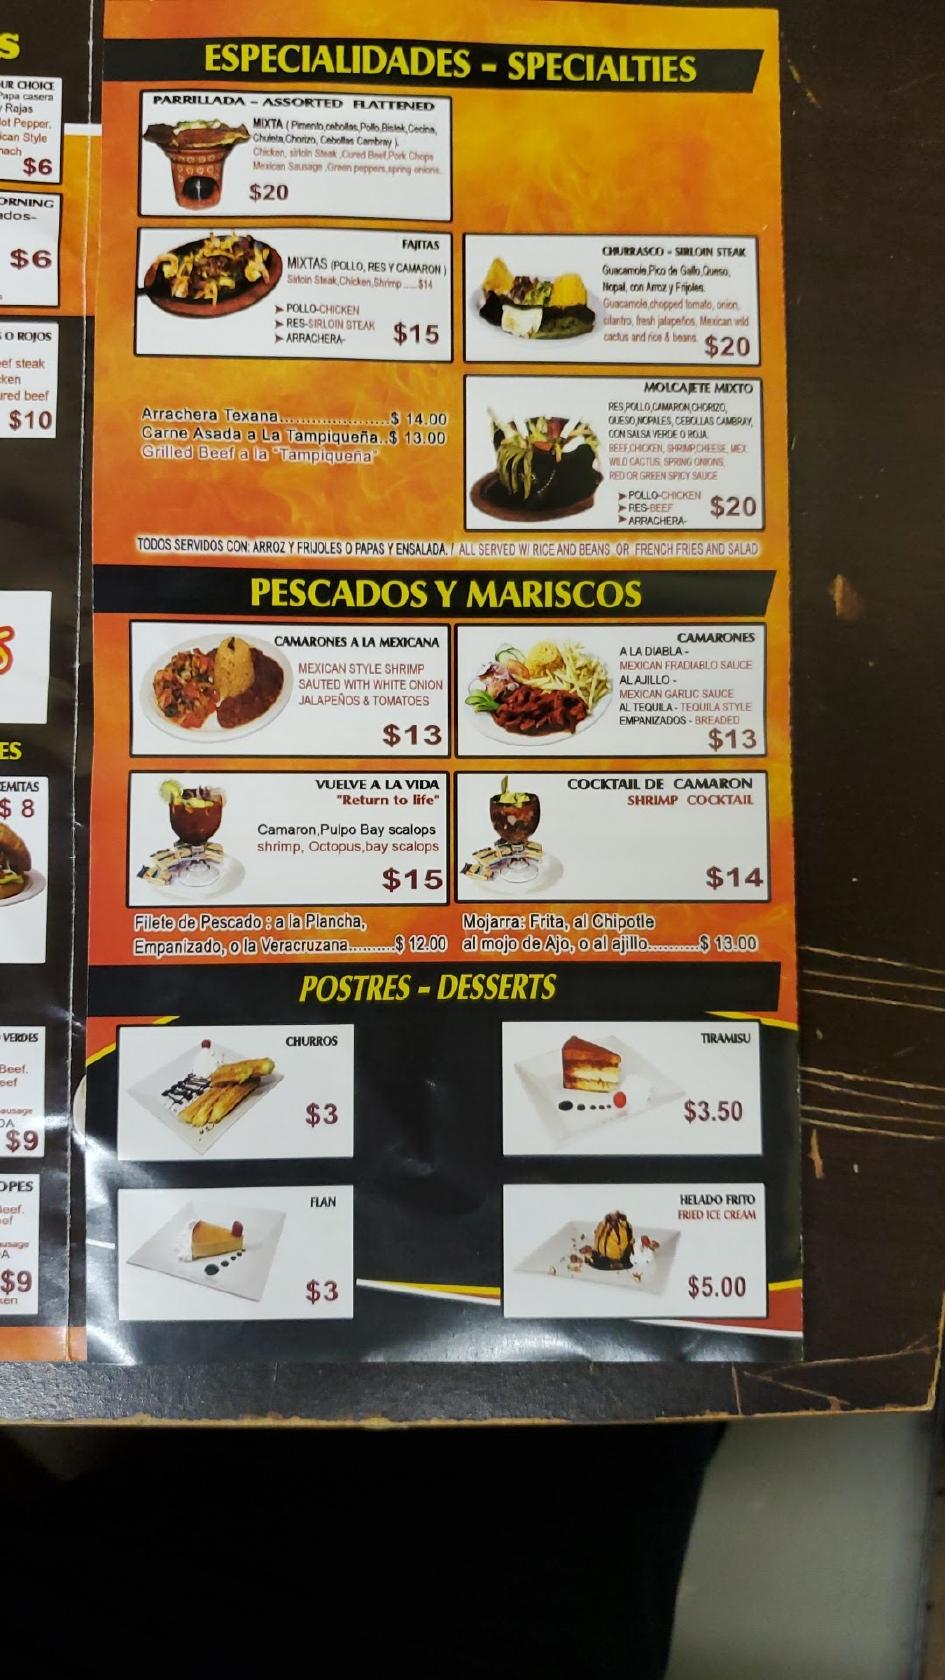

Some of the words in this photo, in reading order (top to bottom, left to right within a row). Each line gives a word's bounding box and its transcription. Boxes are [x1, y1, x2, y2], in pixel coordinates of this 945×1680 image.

[205, 43, 472, 78] ESPECIALIDADES
[508, 51, 697, 83] SPECIALTIES
[18, 81, 54, 90] CHOICE
[6, 105, 33, 115] Rajas
[153, 96, 244, 105] PARRILLADA
[262, 98, 342, 108] ASSORTED
[353, 100, 434, 111] FLATTENED
[253, 118, 282, 129] MIXTA
[23, 133, 47, 144] Style
[23, 157, 52, 176] $6
[250, 184, 288, 202] $20
[402, 240, 439, 251] FAJITAS
[602, 247, 664, 256] CHURRASCO
[676, 247, 712, 257] SIRLOIN
[717, 248, 746, 257] STEAK
[10, 249, 52, 269] $6
[288, 257, 327, 269] MIXTAS
[368, 262, 386, 272] RES
[396, 263, 440, 274] CAMARON
[346, 320, 375, 331] STEAK
[18, 332, 52, 342] ROJOS
[394, 320, 439, 346] $15
[705, 334, 750, 359] $20
[16, 359, 45, 369] steak
[644, 382, 711, 395] MOLCAJETE
[714, 383, 753, 393] MIXTO
[25, 391, 49, 400] beef
[9, 409, 52, 431] $10
[142, 408, 217, 421] Arrachera
[406, 414, 447, 425] 14.00
[142, 426, 187, 439] Carne
[193, 427, 241, 440] Asada
[262, 429, 280, 441] La
[405, 431, 445, 444] 13.00
[142, 445, 192, 458] Grilled
[199, 447, 234, 459] Beef
[254, 447, 267, 459] la
[711, 495, 756, 518] $20
[138, 537, 171, 551] TODOS
[174, 538, 223, 552] SERVIDOS
[253, 540, 286, 553] ARROZ
[298, 541, 342, 554] FRIJOLES
[356, 542, 384, 555] PAPAS
[459, 543, 476, 555] ALL
[479, 543, 515, 555] SERVED
[533, 543, 555, 555] RICE
[557, 543, 576, 555] AND
[579, 543, 610, 555] BEANS
[616, 543, 629, 555] OR
[635, 543, 673, 555] FRENCH
[676, 543, 703, 555] FRIES
[706, 543, 725, 555] AND
[728, 543, 758, 555] SALAD
[251, 578, 428, 607] PESCADOS
[434, 581, 457, 607] Y
[466, 580, 641, 608] MARISCOS
[274, 636, 347, 648] CAMARONES
[362, 636, 377, 648] LA
[379, 636, 440, 648] MEXICANA
[677, 632, 755, 643] CAMARONES
[645, 646, 683, 656] DIABLA
[298, 663, 347, 675] MEXICAN
[350, 663, 382, 675] STYLE
[385, 663, 424, 675] SHRIMP
[620, 660, 662, 670] MEXICAN
[721, 660, 752, 670] SAUCE
[298, 680, 341, 690] SAUTED
[344, 680, 371, 690] WITH
[374, 680, 406, 690] WHITE
[409, 680, 442, 690] ONION
[298, 693, 360, 706] JALAPEÑOS
[373, 696, 429, 706] TOMATOES
[620, 689, 662, 699] MEXICAN
[665, 689, 700, 699] GARLIC
[703, 689, 734, 699] SAUCE
[634, 703, 673, 712] TEQUILA
[681, 703, 720, 712] TEQUILA
[723, 703, 752, 712] STYLE
[620, 716, 686, 725] EMPANIZADOS
[695, 716, 739, 725] BREADED
[383, 724, 442, 747] $13
[708, 728, 756, 751] $13
[316, 780, 367, 790] VUELVE
[371, 780, 382, 790] A
[386, 780, 402, 790] LA
[405, 780, 440, 790] VIDA
[568, 778, 641, 790] COCKTAIL
[645, 778, 664, 790] DE
[674, 778, 752, 790] CAMARON
[394, 795, 408, 806] to
[627, 795, 678, 805] SHRIMP
[687, 795, 754, 805] COCKTAIL
[360, 824, 384, 838] Bay
[388, 824, 436, 838] scalops
[392, 841, 440, 854] scalops
[382, 867, 443, 893] $15
[706, 866, 763, 889] $14
[135, 915, 173, 929] Filete
[178, 915, 196, 929] de
[201, 915, 262, 929] Pescado
[289, 915, 302, 929] la
[307, 915, 366, 930] Plancha,
[464, 915, 525, 930] Mojarra:
[530, 915, 569, 930] Frita,
[573, 915, 586, 928] al
[592, 915, 654, 930] Chipotle
[134, 939, 224, 957] Empanizado,
[244, 939, 257, 953] la
[410, 937, 447, 951] 12.00
[463, 936, 477, 950] al
[482, 937, 517, 952] mojo
[522, 936, 541, 950] de
[593, 936, 607, 950] al
[715, 937, 756, 950] 13.00
[299, 975, 411, 1001] POSTRES
[437, 974, 556, 1000] DESSERTS
[3, 1033, 38, 1042] VERDES
[286, 1036, 338, 1047] CHURROS
[701, 1033, 750, 1043] TIRAMISU
[306, 1103, 338, 1127] $3
[684, 1099, 742, 1124] $3.50
[6, 1129, 38, 1152] $9
[311, 1197, 336, 1207] FLAN
[680, 1194, 722, 1205] HELADO
[726, 1194, 755, 1205] FRITO
[678, 1210, 703, 1220] FRIED
[706, 1210, 720, 1220] ICE
[724, 1210, 756, 1220] CREAM
[1, 1269, 32, 1294] $9
[688, 1275, 746, 1298] $5.00
[306, 1279, 338, 1304] $3
